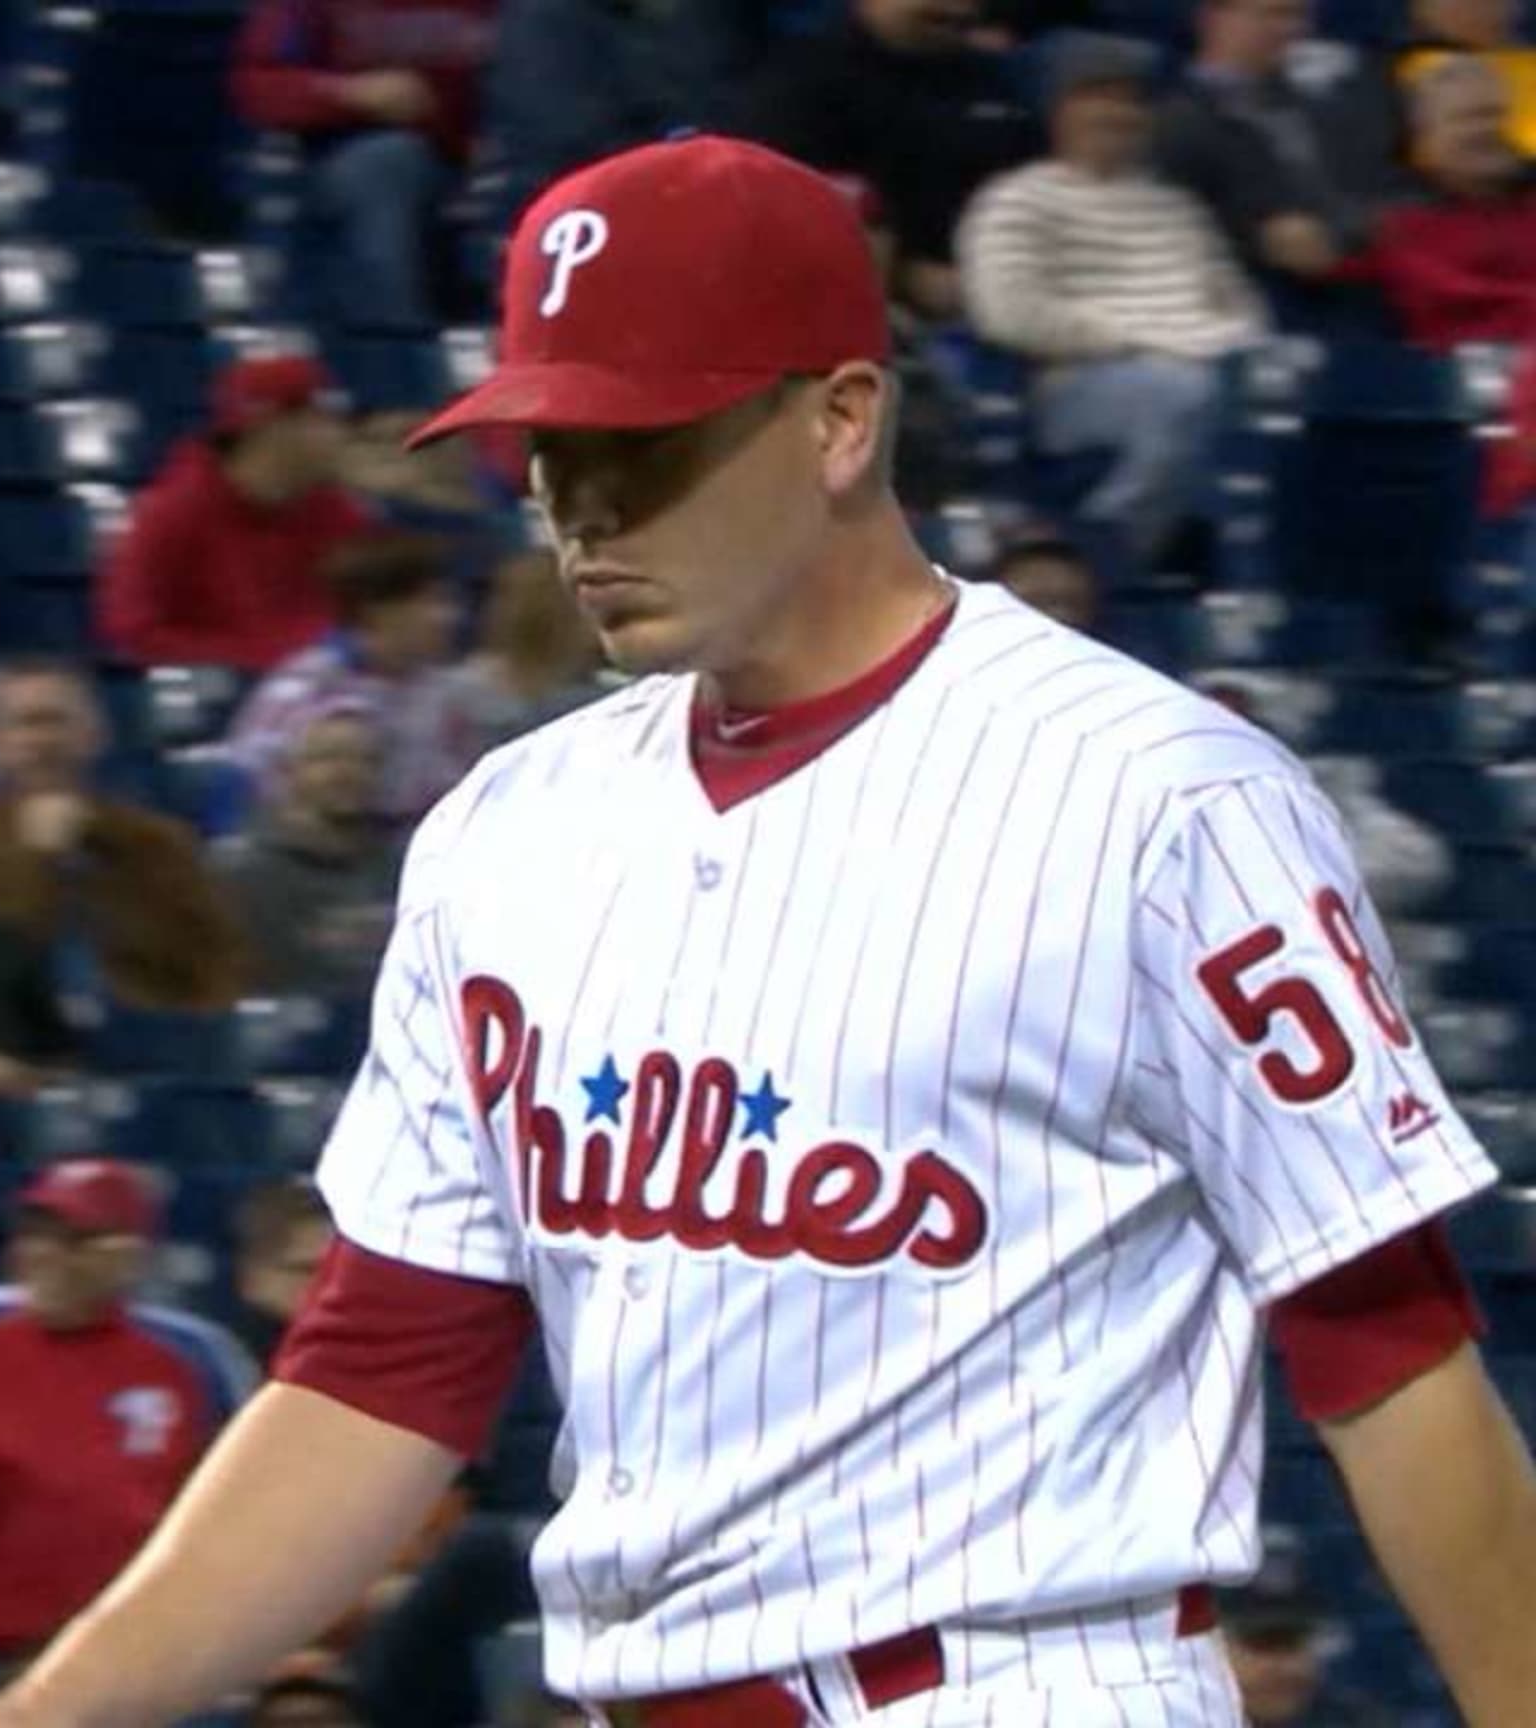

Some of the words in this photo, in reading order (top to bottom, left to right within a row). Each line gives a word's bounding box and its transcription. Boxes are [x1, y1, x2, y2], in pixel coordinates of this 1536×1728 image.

[539, 209, 609, 318] P
[1195, 886, 1413, 1106] 58
[459, 973, 990, 1268] Phillies
